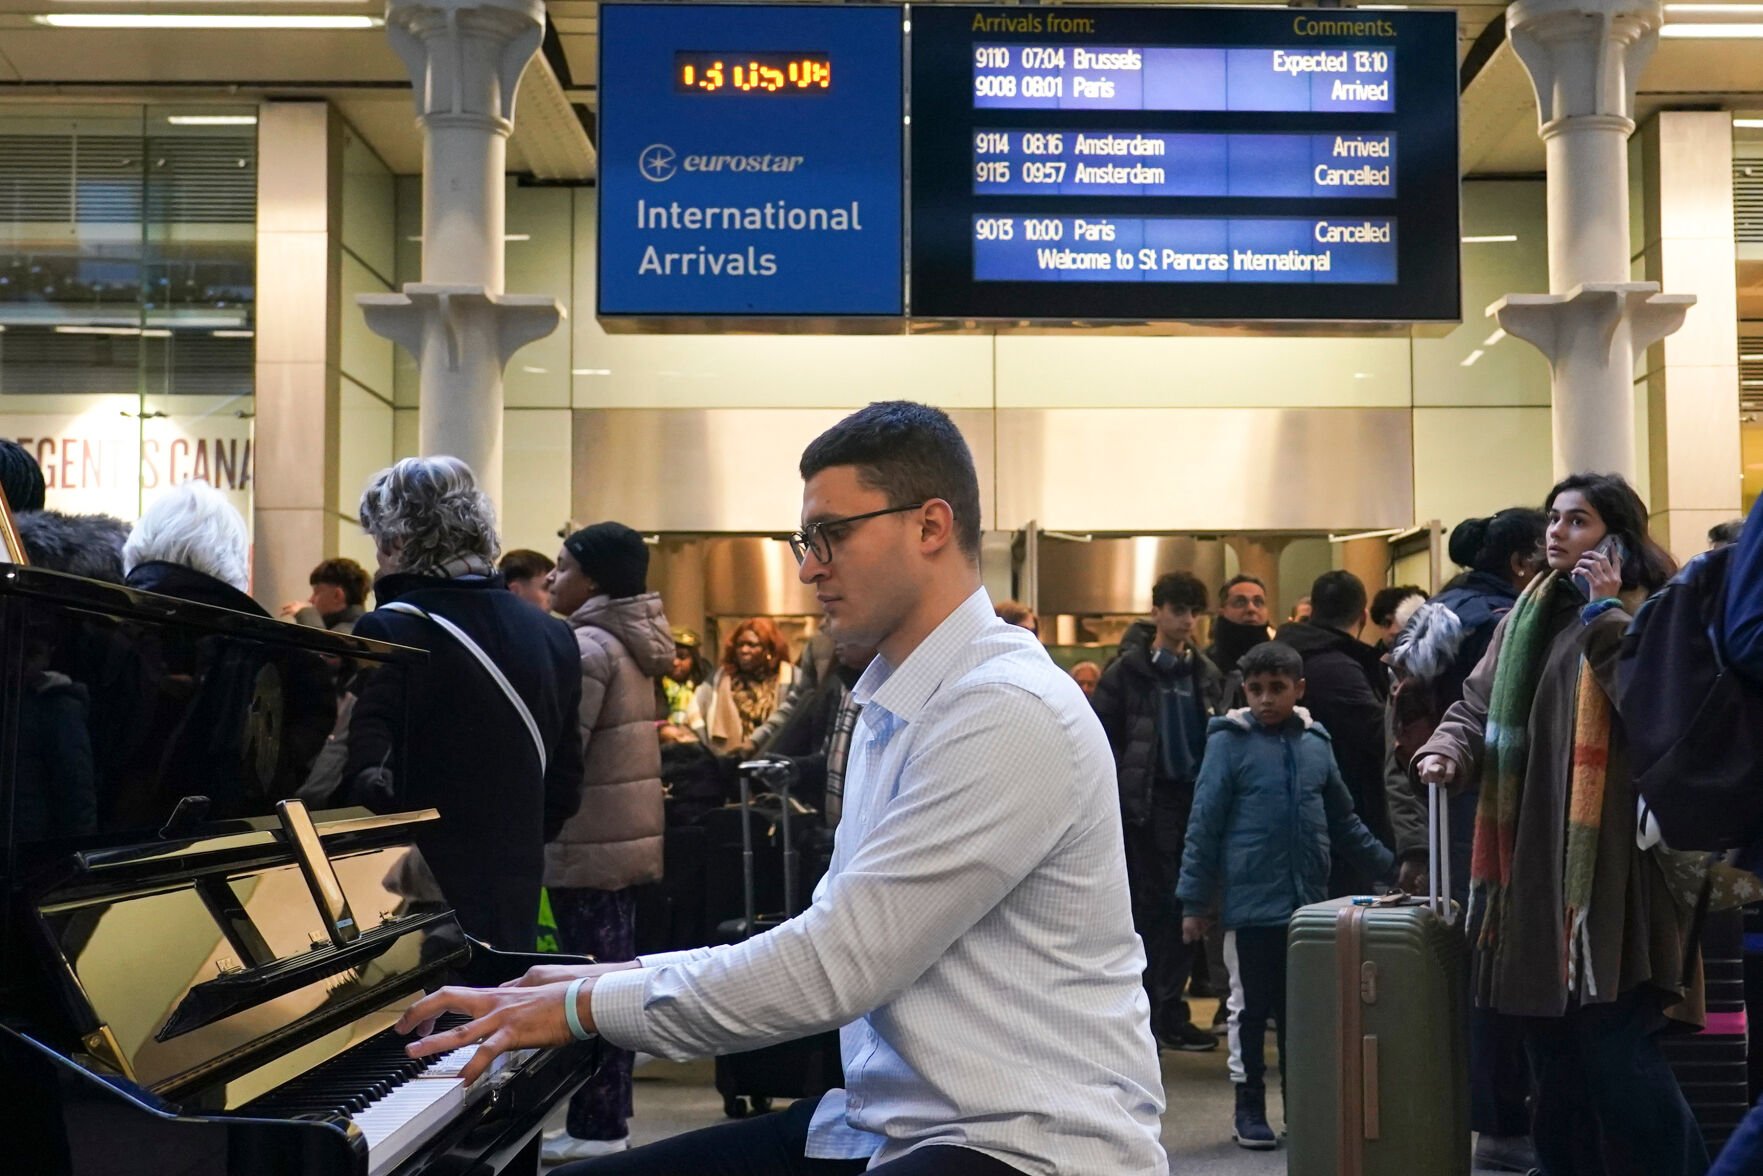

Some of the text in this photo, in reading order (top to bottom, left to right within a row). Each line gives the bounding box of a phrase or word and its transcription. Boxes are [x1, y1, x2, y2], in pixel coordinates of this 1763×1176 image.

[972, 13, 1095, 33] Arrivals from:
[1293, 16, 1397, 36] Comments.
[975, 48, 1009, 68] 9110
[1073, 49, 1142, 70] Brussels
[1273, 51, 1347, 76] Expected
[1353, 52, 1388, 72] 13:10
[1073, 77, 1115, 98] Paris
[1331, 80, 1388, 100] Arrived
[976, 133, 1010, 153] 9114
[1074, 134, 1165, 155] Amsterdam
[1332, 136, 1390, 157] Arrived
[683, 153, 804, 172] eurostar
[976, 162, 1010, 182] 9115
[1074, 162, 1165, 184] Amsterdam
[1314, 164, 1390, 186] Cancelled
[637, 199, 862, 230] International
[976, 219, 1390, 243] 9013 10:00 Paris Cancelled
[638, 245, 777, 276] Arrivals
[1036, 248, 1331, 271] Welcome to St Pancras International
